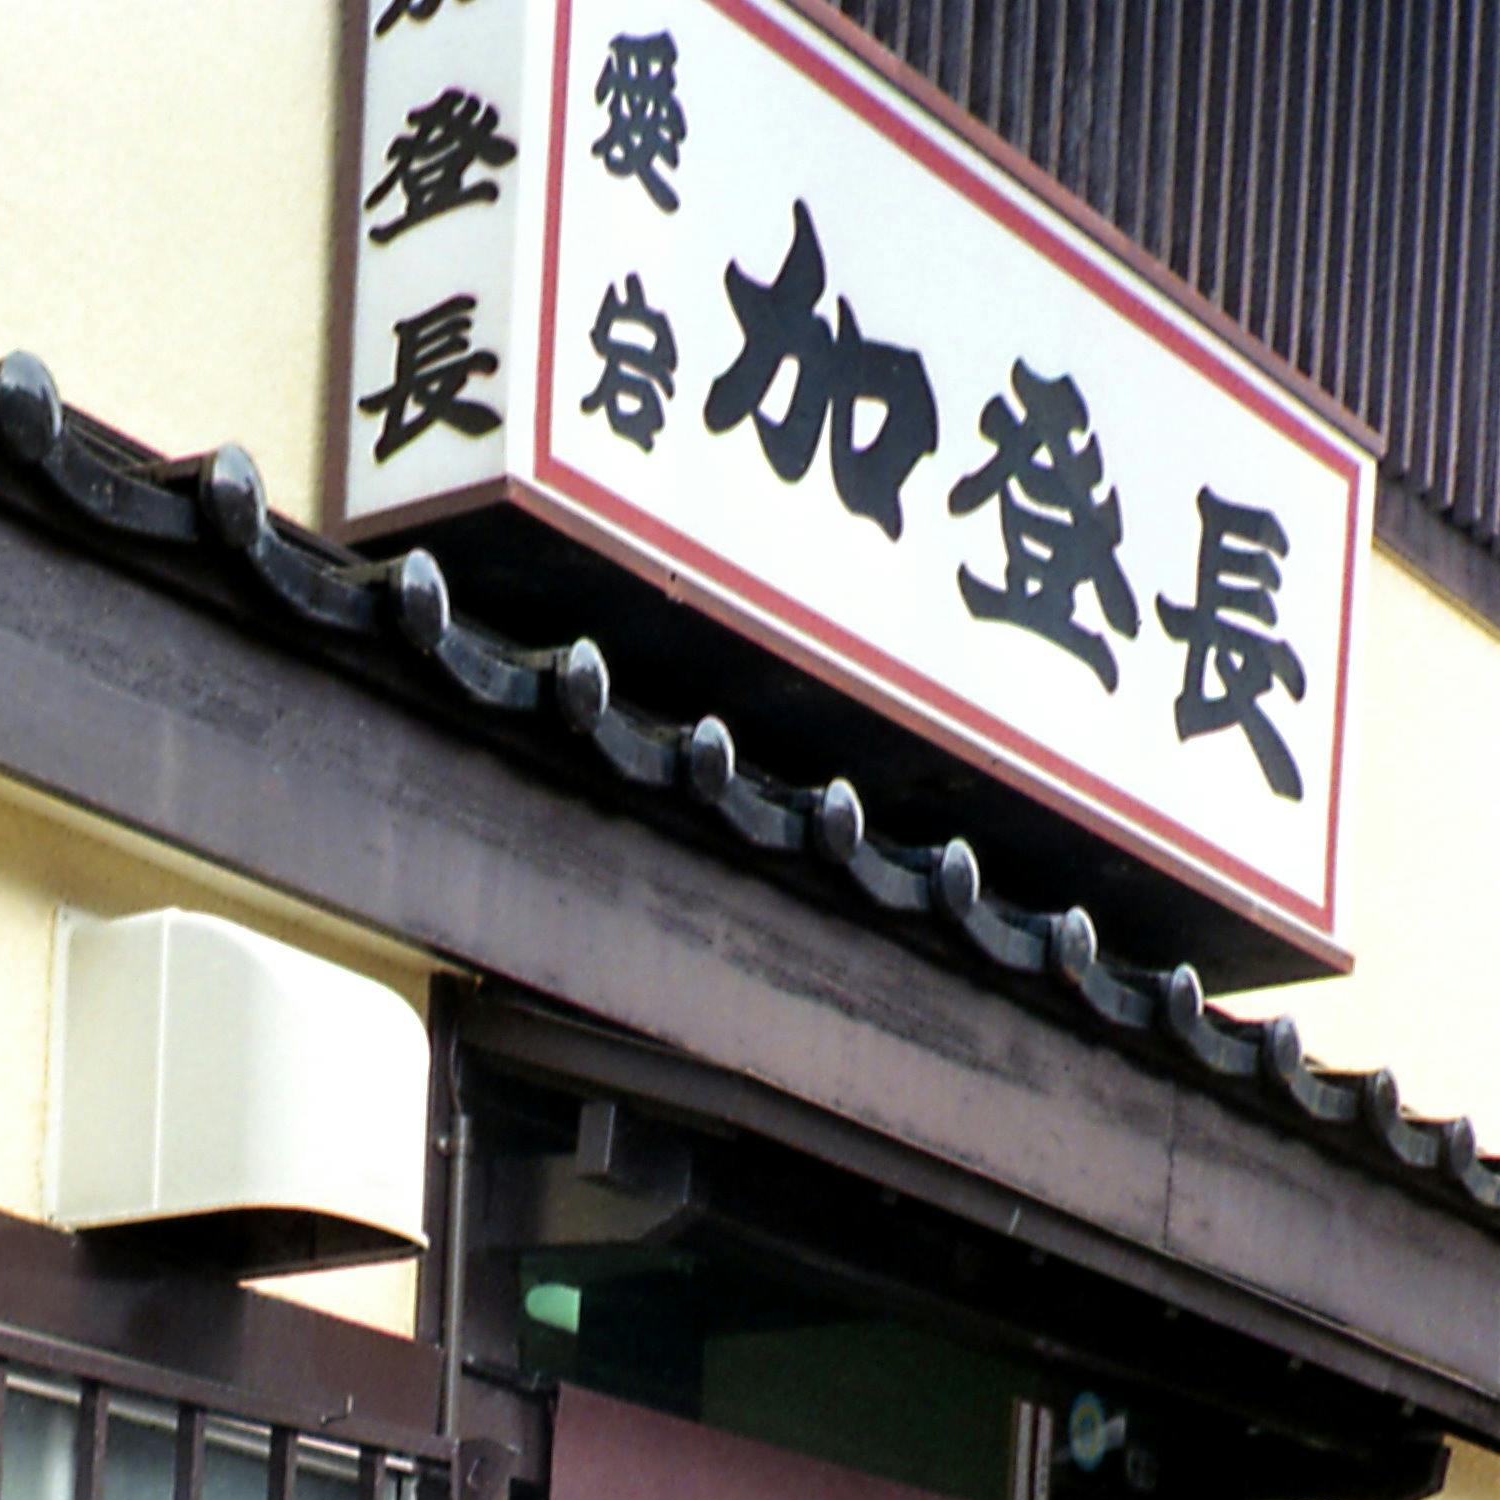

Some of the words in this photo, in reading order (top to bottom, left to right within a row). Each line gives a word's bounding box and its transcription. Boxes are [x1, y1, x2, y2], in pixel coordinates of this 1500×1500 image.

[359, 0, 517, 464] 登長
[703, 197, 1305, 802] 加登長
